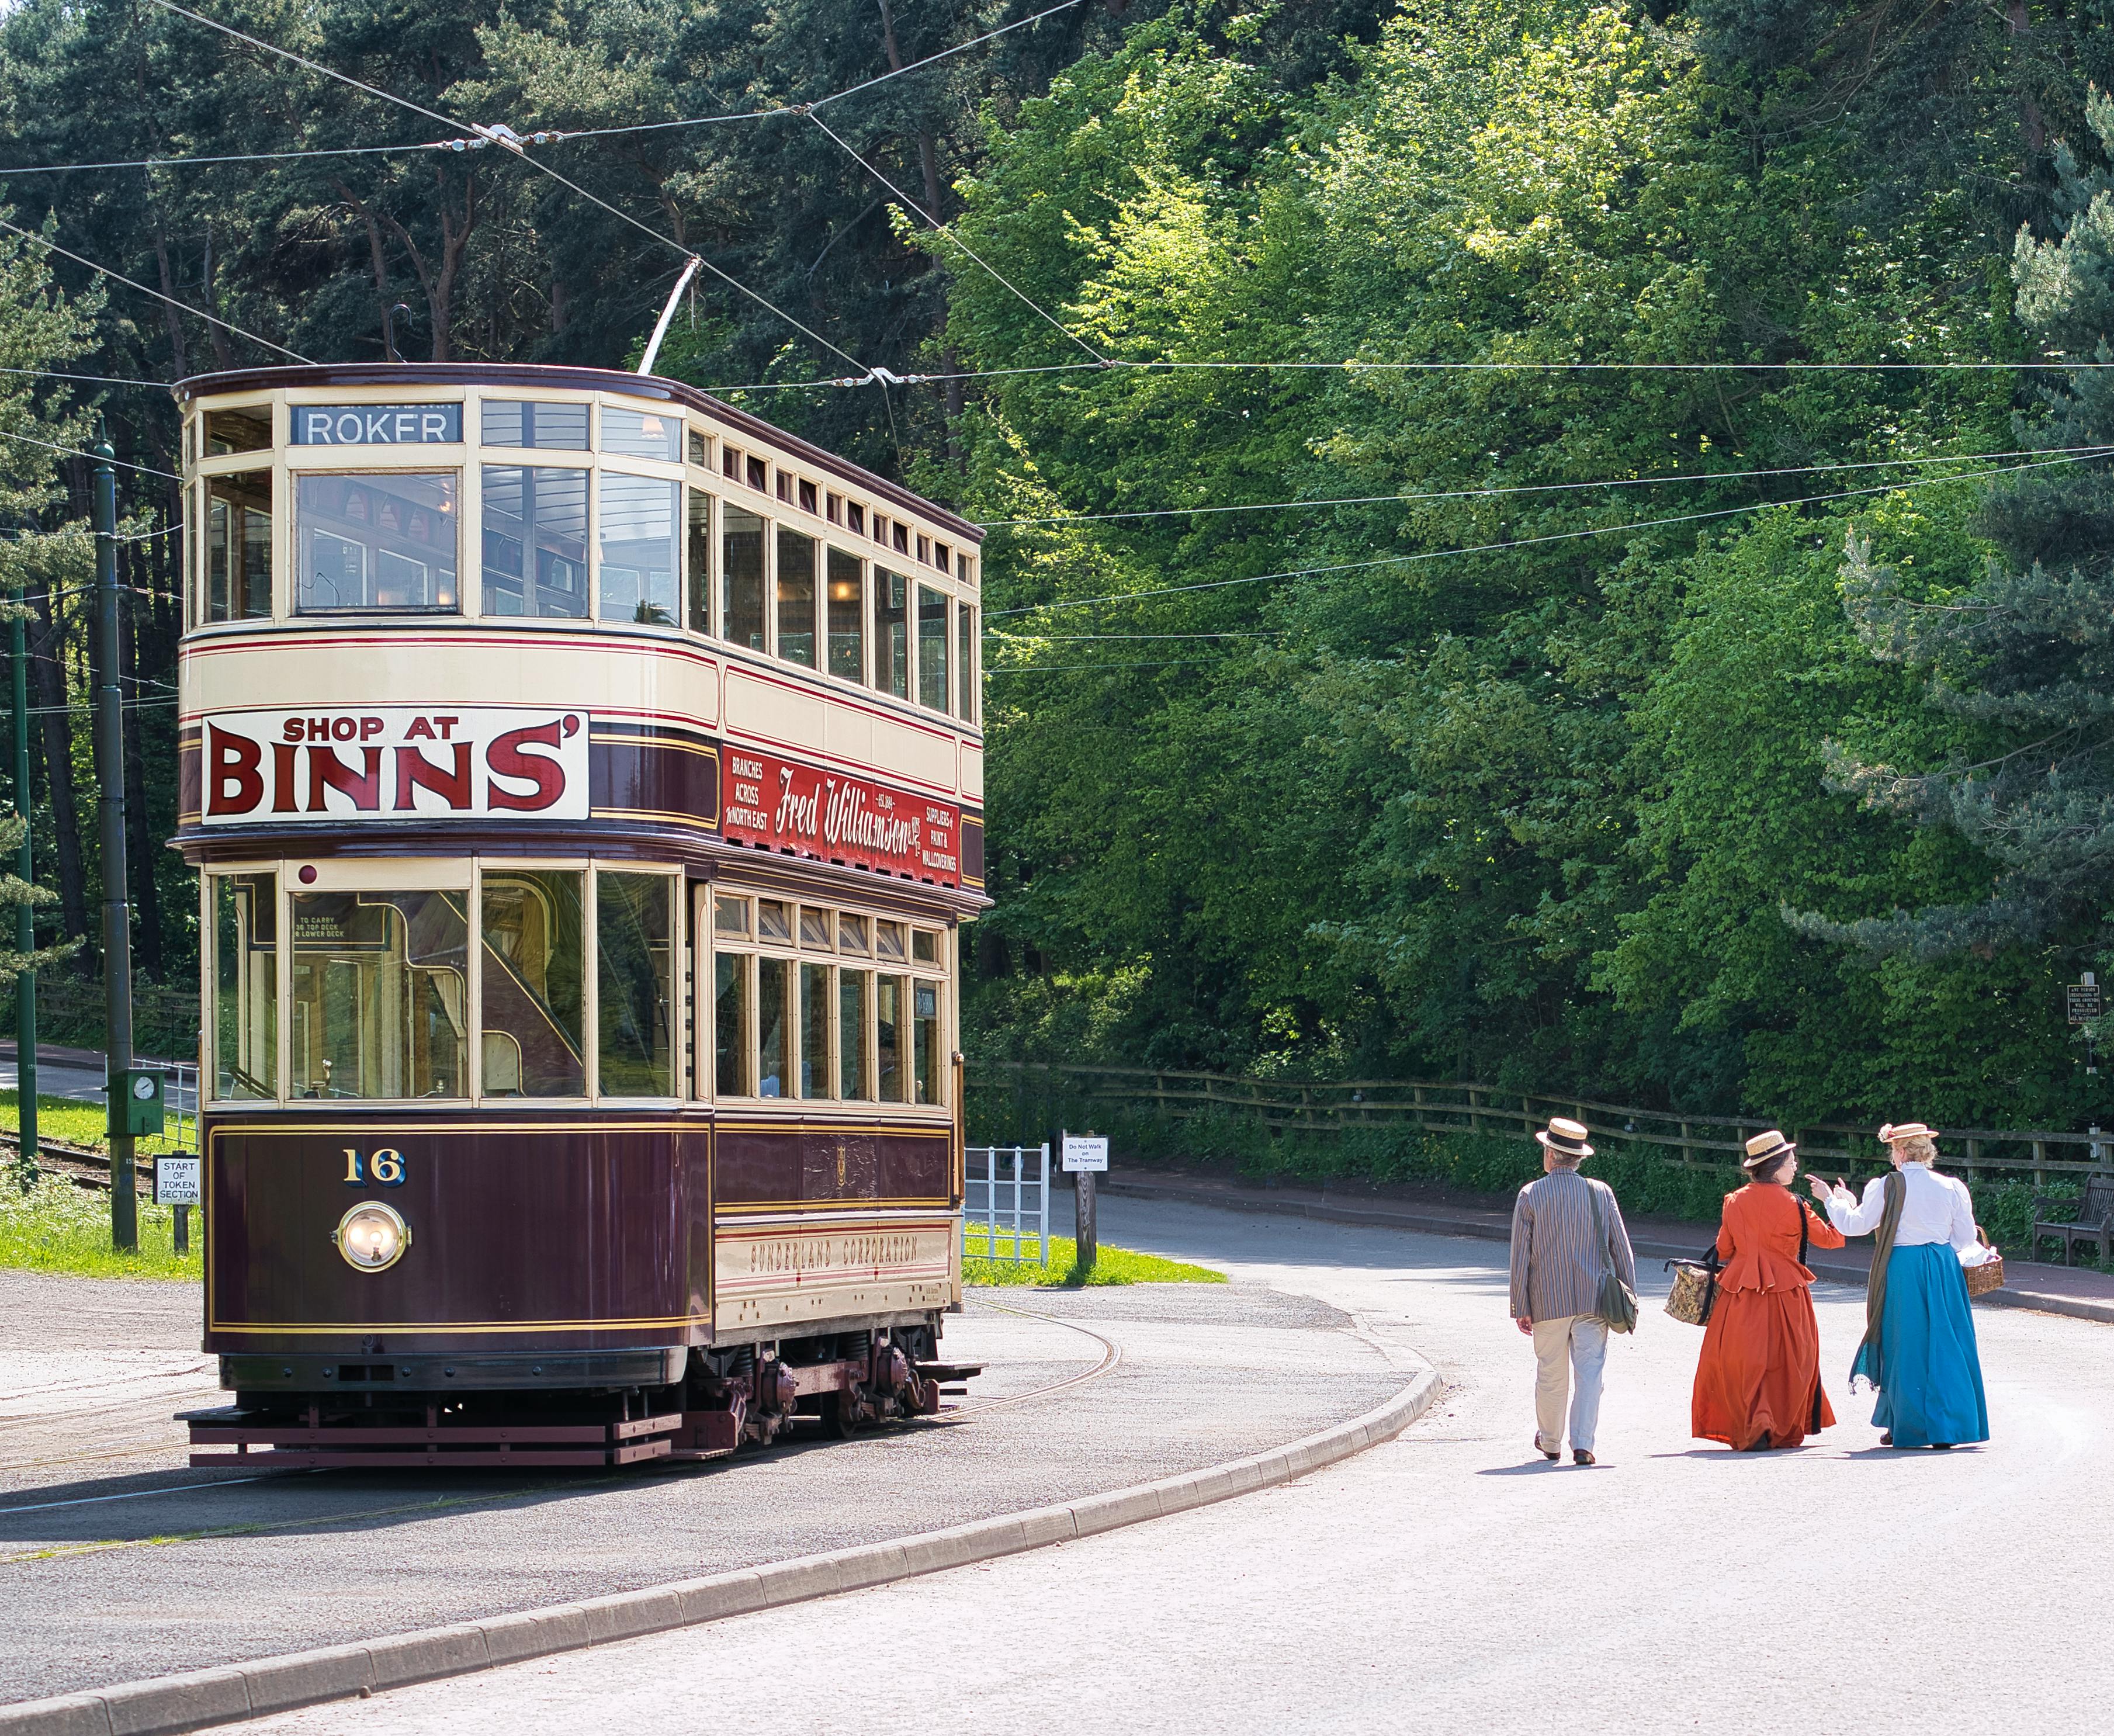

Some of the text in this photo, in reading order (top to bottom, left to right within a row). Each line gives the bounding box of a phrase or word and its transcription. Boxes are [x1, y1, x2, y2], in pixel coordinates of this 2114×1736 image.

[308, 414, 448, 444] ROKER
[283, 716, 459, 741] SHOP AT
[732, 756, 763, 780] BRANCHES
[735, 782, 758, 806] ACROSS
[775, 767, 820, 836] Fred
[732, 806, 751, 827] NORTH
[752, 810, 767, 830] EAST
[926, 806, 949, 827] SUPPLIERS
[931, 829, 948, 848] PAINT &
[922, 849, 957, 872] WALLCOVERINGS
[164, 1162, 195, 1170] START
[172, 1172, 186, 1180] OF
[342, 1148, 407, 1187] 16
[160, 1190, 198, 1198] SECTION
[163, 1181, 195, 1189] TOKEN
[751, 1236, 917, 1273] SUNDERLAND CORPORATION
